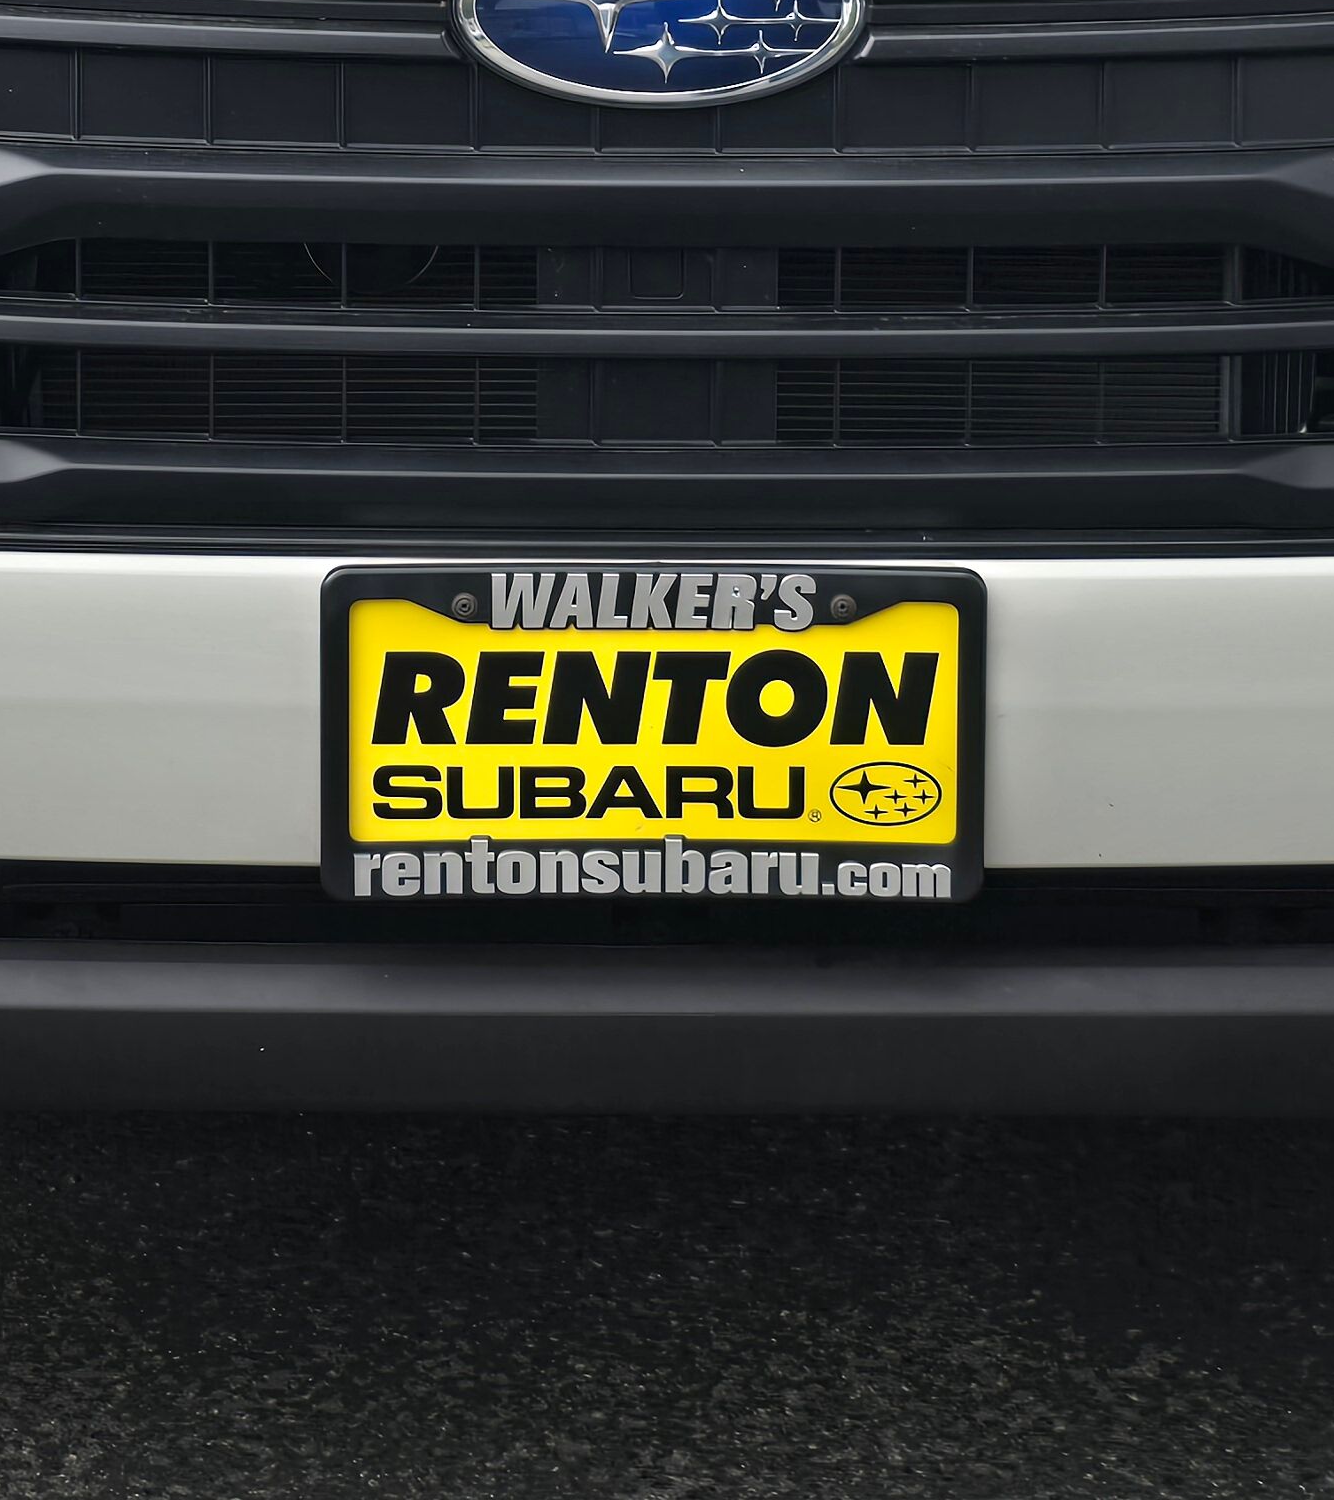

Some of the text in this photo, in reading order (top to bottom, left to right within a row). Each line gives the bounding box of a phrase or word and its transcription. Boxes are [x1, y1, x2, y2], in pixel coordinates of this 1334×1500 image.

[490, 572, 816, 632] WALKER'S
[370, 649, 940, 748] RENTON
[372, 765, 805, 820] SUBARU
[353, 838, 952, 898] rentonsubaru.com
